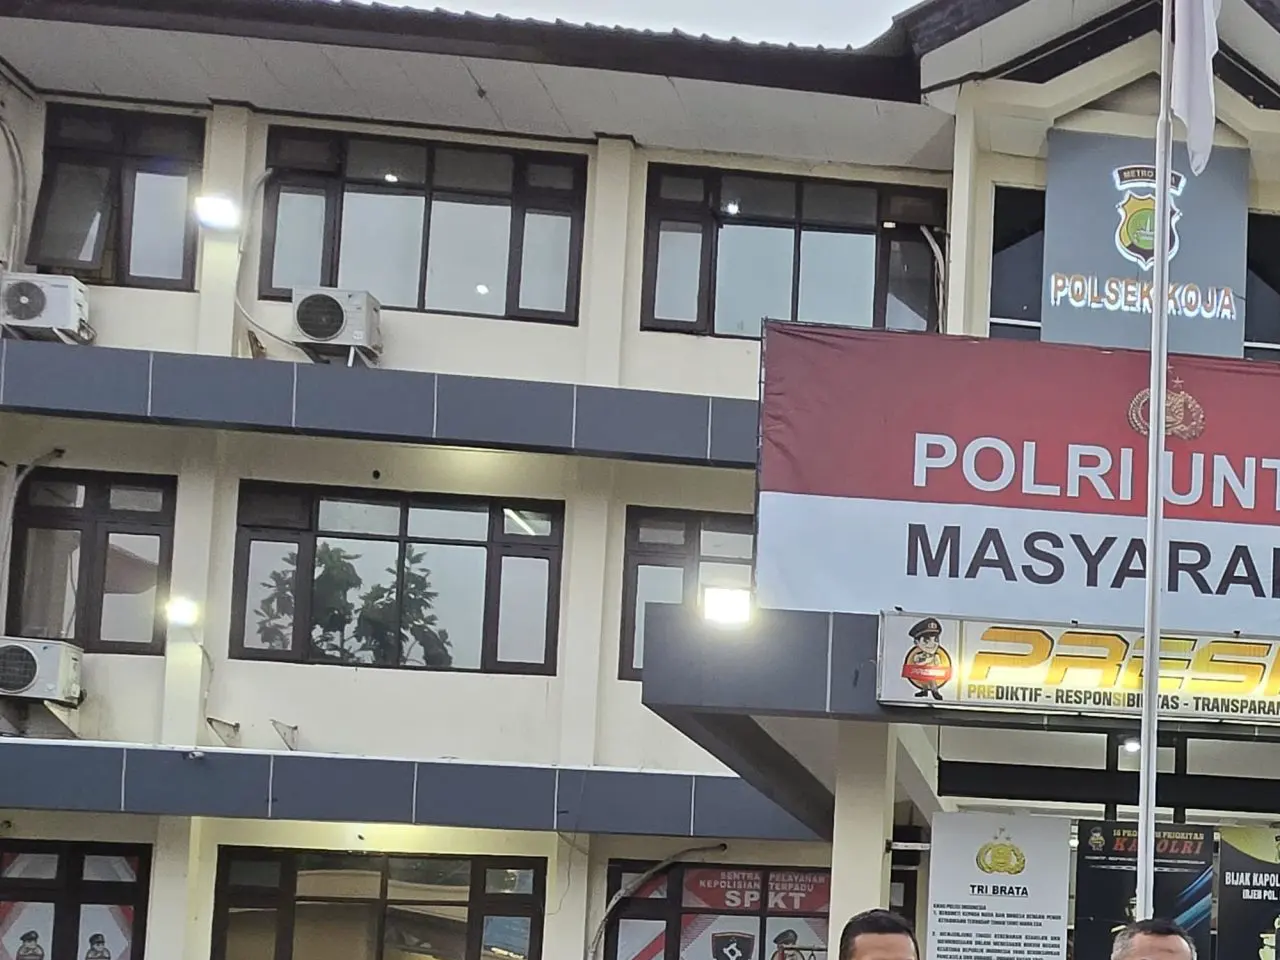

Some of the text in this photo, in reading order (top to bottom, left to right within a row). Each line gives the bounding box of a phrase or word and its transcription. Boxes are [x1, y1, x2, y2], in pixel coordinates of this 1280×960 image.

[1123, 169, 1154, 179] METRO
[1051, 273, 1237, 320] POLSEK KOJA
[913, 432, 1133, 501] POLRI
[967, 683, 1043, 705] PREDIKTIF
[1055, 688, 1180, 710] RESPONSIBITAS
[1112, 838, 1205, 855] KAOLRI
[720, 871, 826, 884] SENTRA PELAYANAN
[1225, 871, 1251, 886] BIJAK
[699, 880, 815, 892] KEPOLISIAN TERPADU
[970, 884, 1029, 896] TRI BRATA
[724, 890, 806, 910] SPKT
[1263, 890, 1279, 901] POL.
